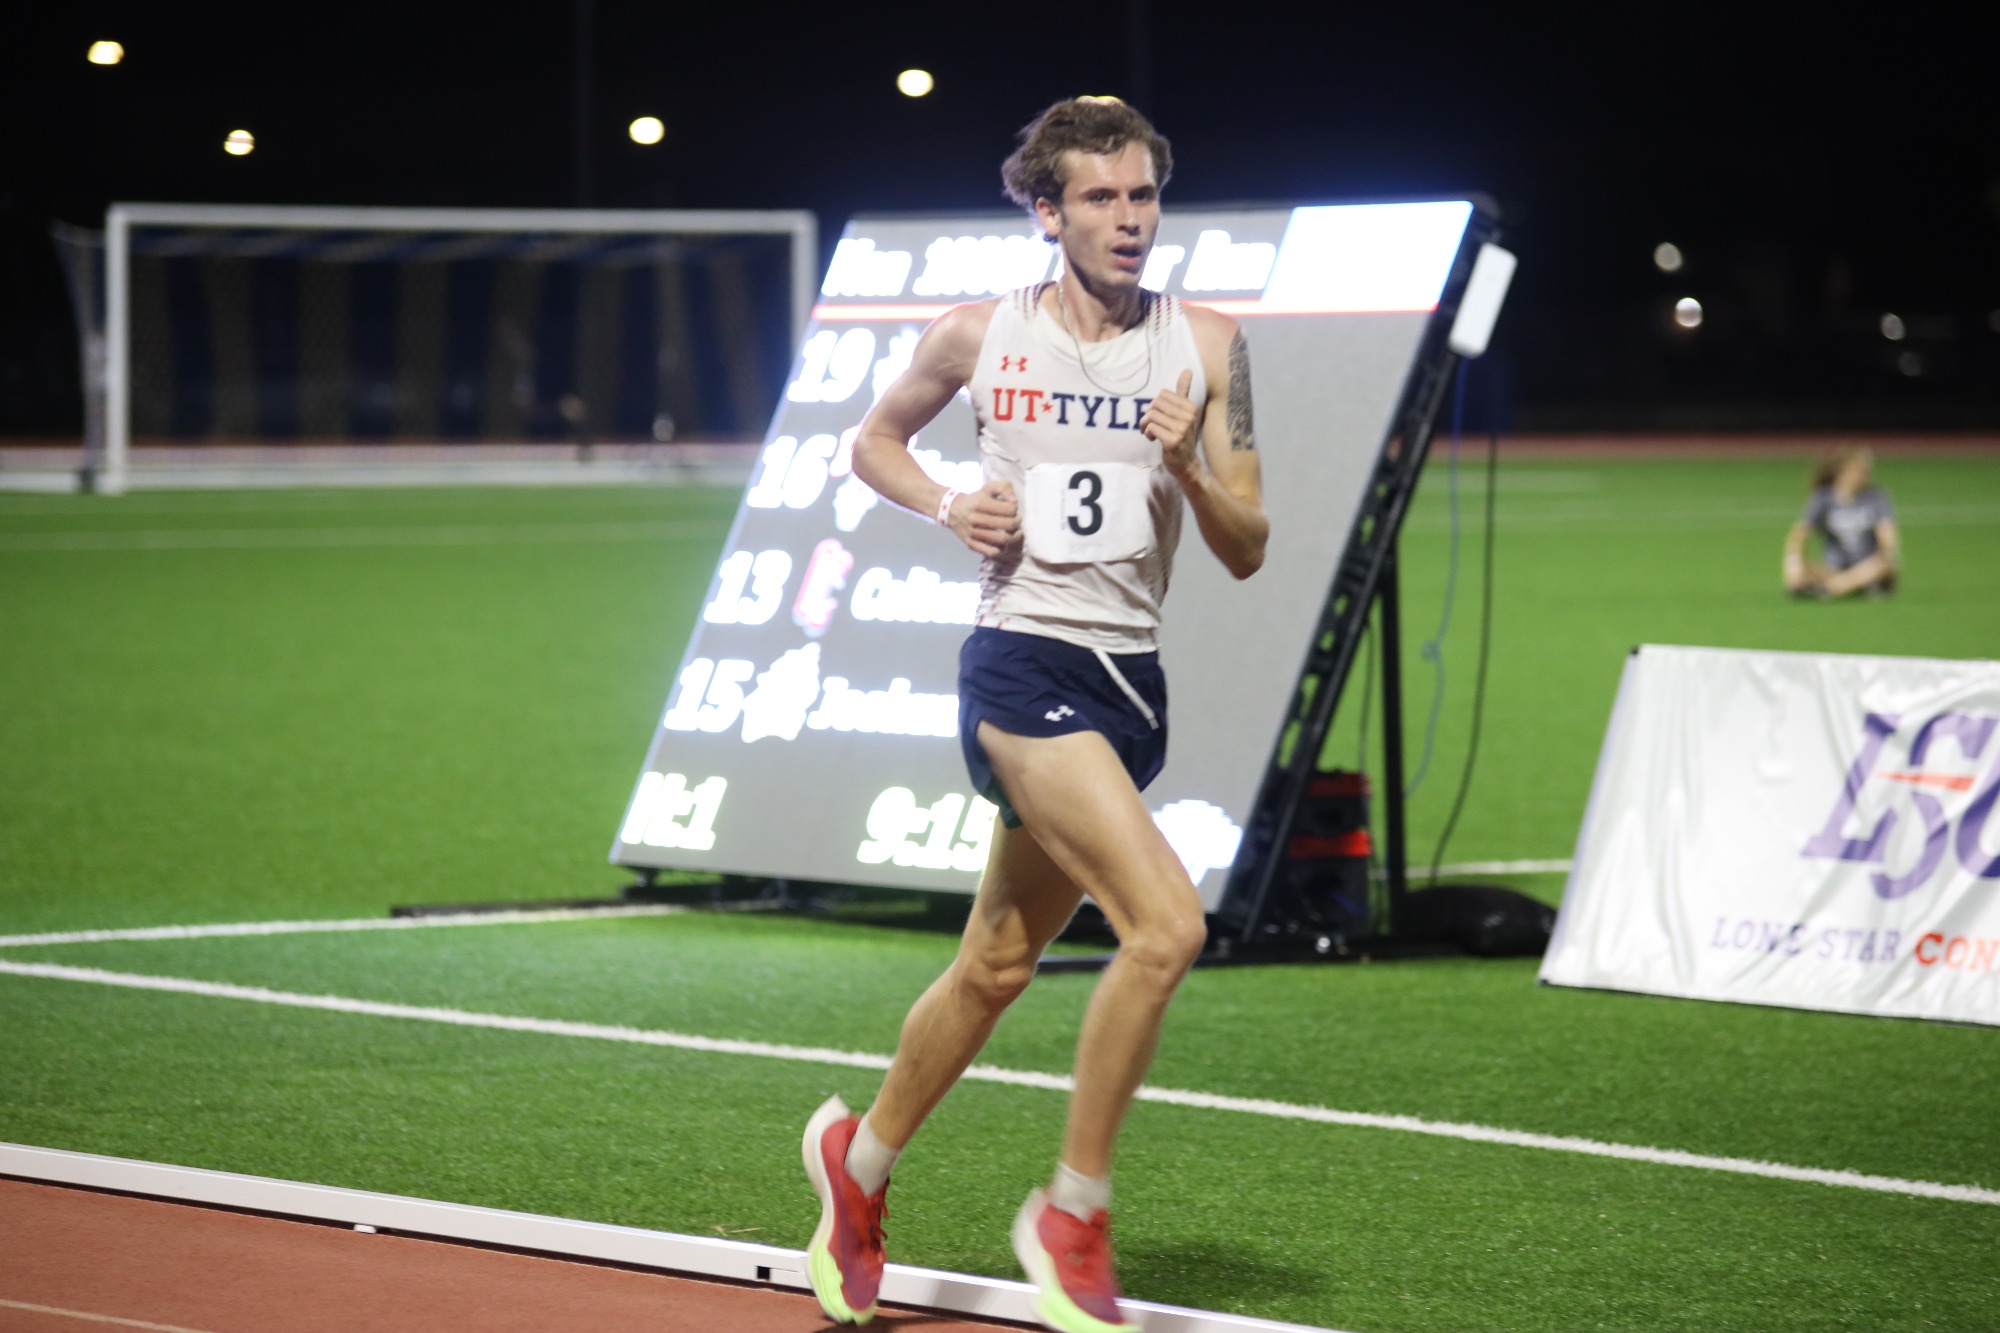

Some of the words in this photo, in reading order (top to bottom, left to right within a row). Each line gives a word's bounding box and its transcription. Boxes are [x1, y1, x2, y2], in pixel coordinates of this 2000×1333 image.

[787, 328, 875, 403] 19
[993, 388, 1043, 422] UT
[1051, 393, 1155, 430] TYLE
[747, 434, 838, 508] 16
[1067, 470, 1103, 536] 3
[704, 550, 792, 625] 13
[664, 658, 755, 732] 15
[1711, 918, 1806, 956] LONE
[1818, 929, 1901, 962] STAR
[1914, 933, 2000, 976] CON
